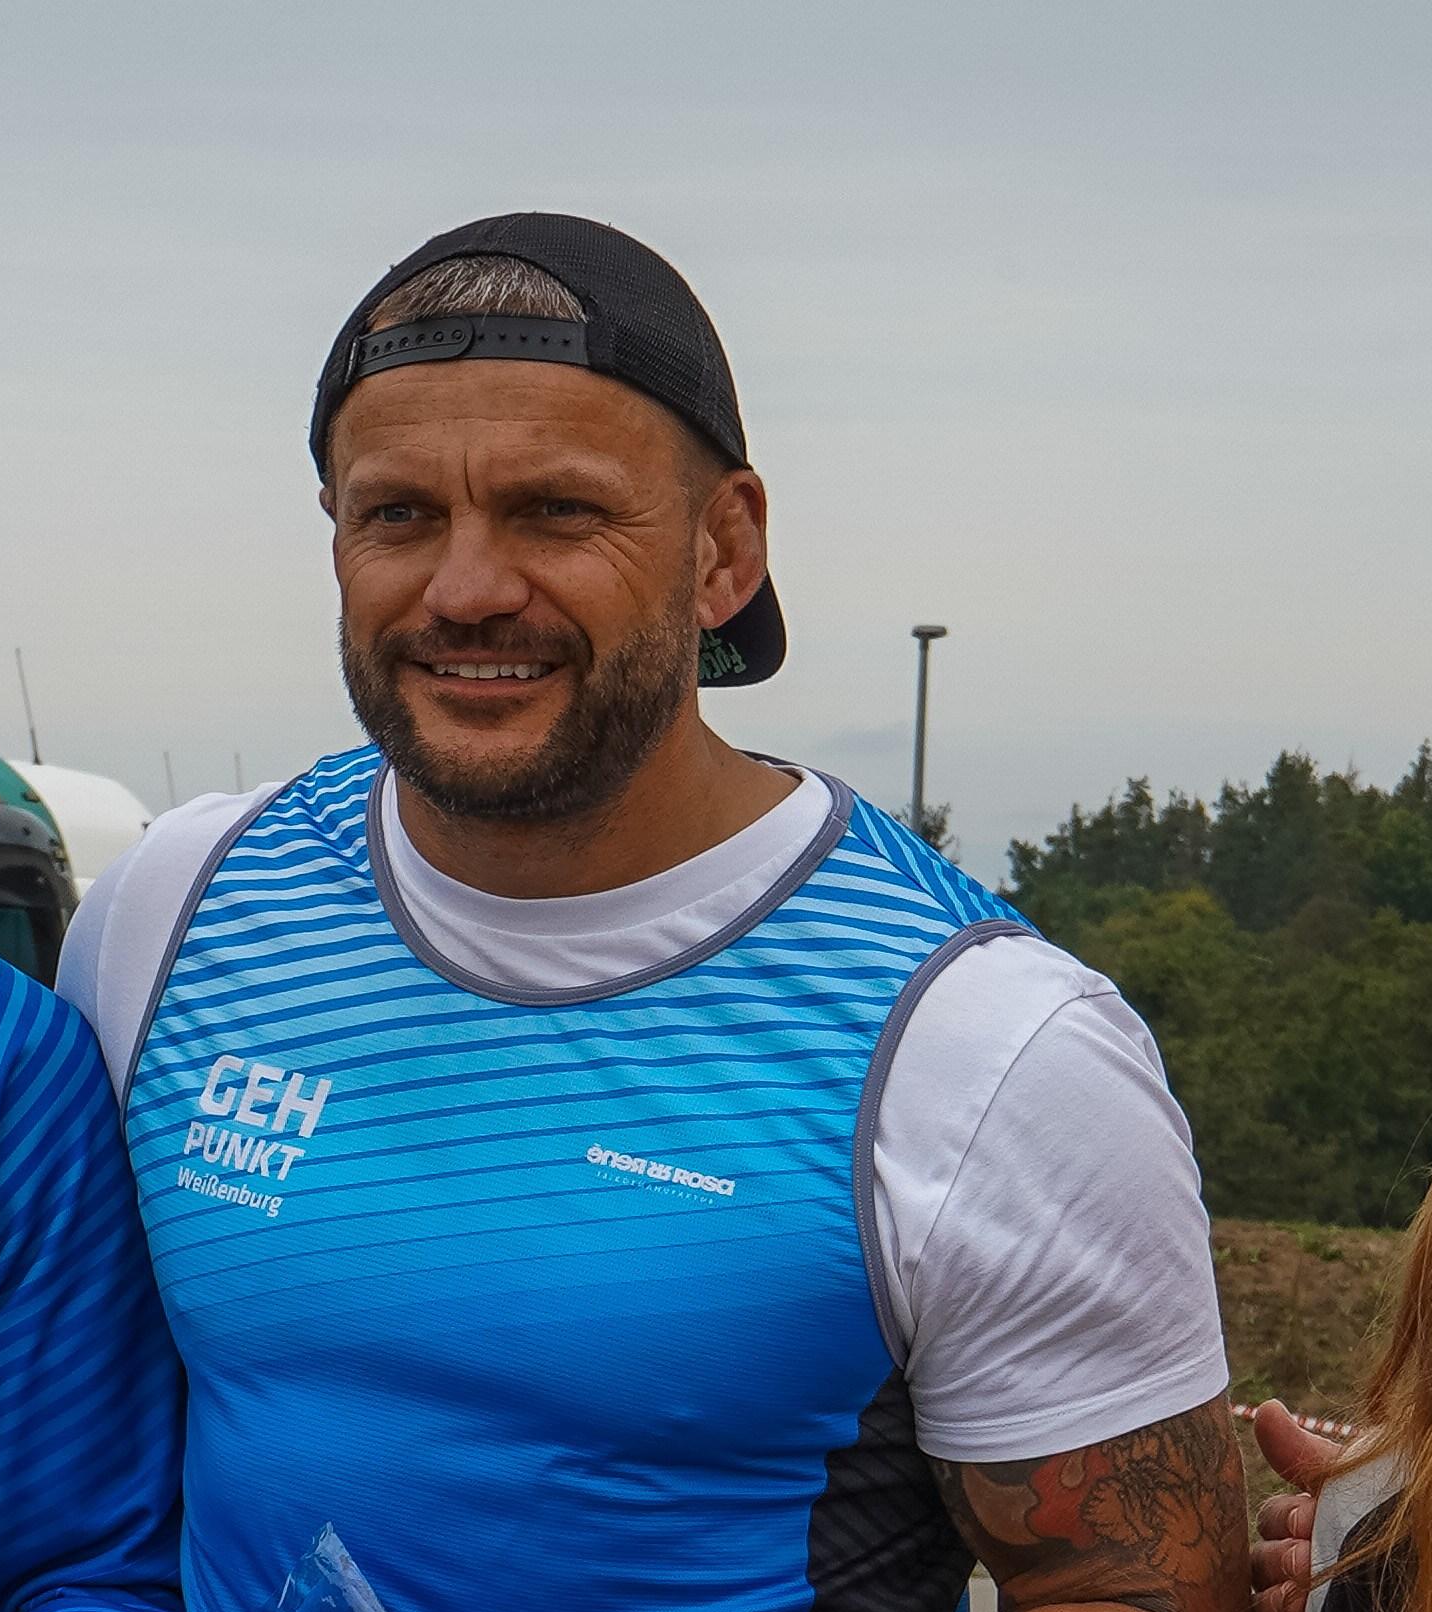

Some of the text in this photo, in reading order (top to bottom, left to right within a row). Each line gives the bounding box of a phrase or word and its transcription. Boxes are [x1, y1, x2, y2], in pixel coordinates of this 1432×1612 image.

[198, 1054, 332, 1138] GEH
[183, 1120, 306, 1181] PUNKT
[176, 1165, 284, 1218] Weißenburg
